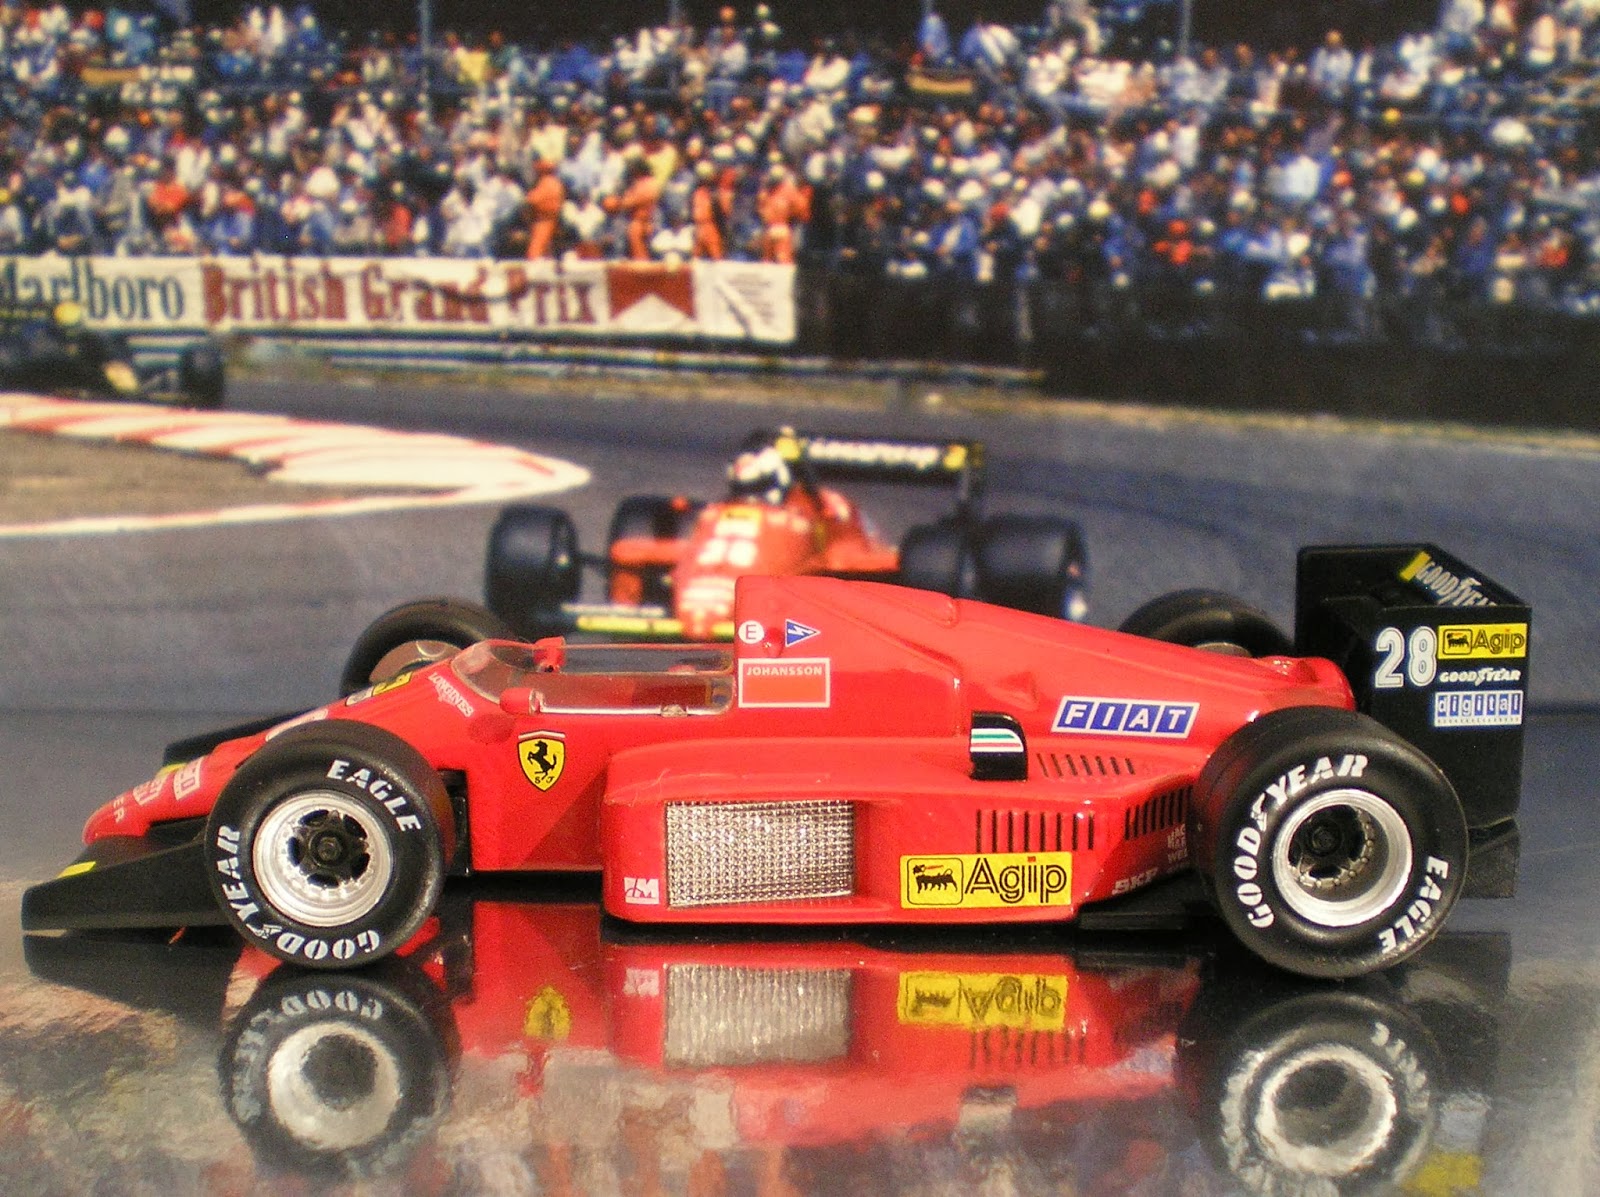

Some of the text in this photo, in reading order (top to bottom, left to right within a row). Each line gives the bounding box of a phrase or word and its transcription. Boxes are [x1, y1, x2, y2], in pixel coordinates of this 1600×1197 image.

[202, 256, 347, 324] British
[359, 261, 490, 323] Grand
[1375, 626, 1437, 688] 28
[1472, 628, 1525, 654] Agip
[428, 671, 475, 718] LONGINES
[747, 666, 823, 676] JOHANSSON
[1439, 667, 1521, 686] GOODYEAR
[1064, 703, 1187, 730] FIAT
[1438, 694, 1519, 717] digital
[327, 759, 422, 832] EAGLE
[1233, 754, 1368, 928] GOODYEAR
[216, 825, 380, 960] GOODYEAR
[965, 856, 1067, 903] Agip
[1378, 856, 1449, 953] EAGLE
